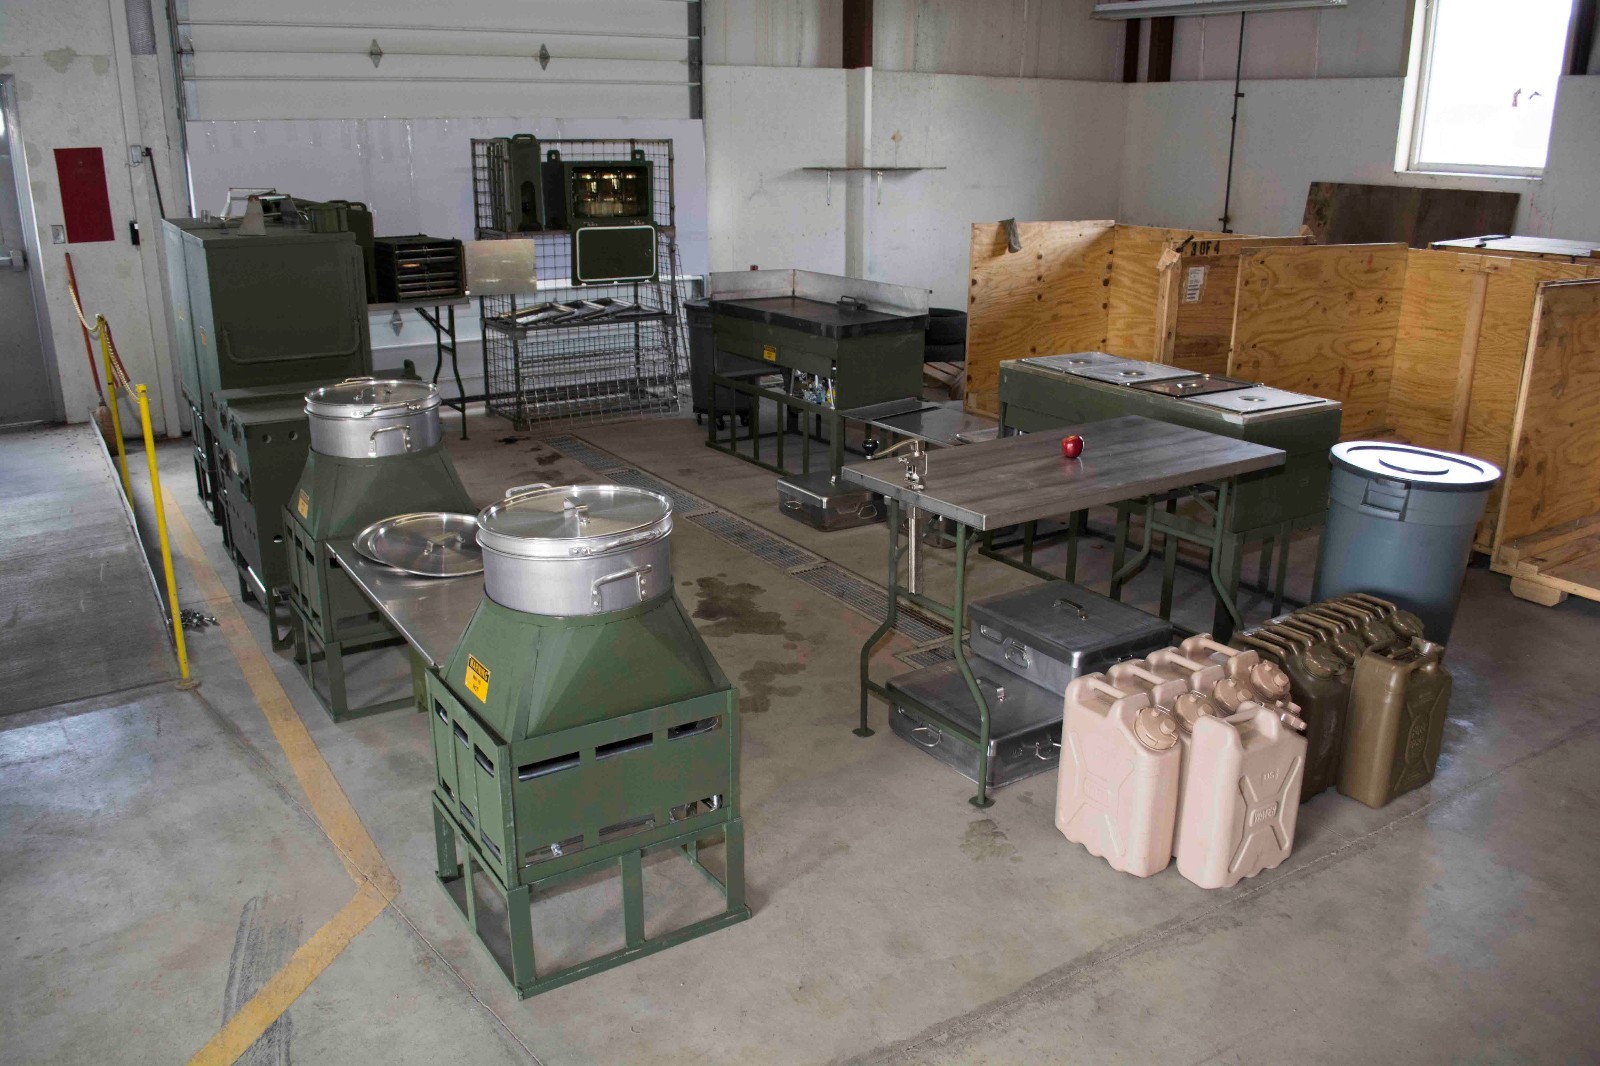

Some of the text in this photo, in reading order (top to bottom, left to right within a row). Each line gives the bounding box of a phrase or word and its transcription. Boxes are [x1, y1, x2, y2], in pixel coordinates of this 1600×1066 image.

[1191, 240, 1220, 256] 3 OF 4
